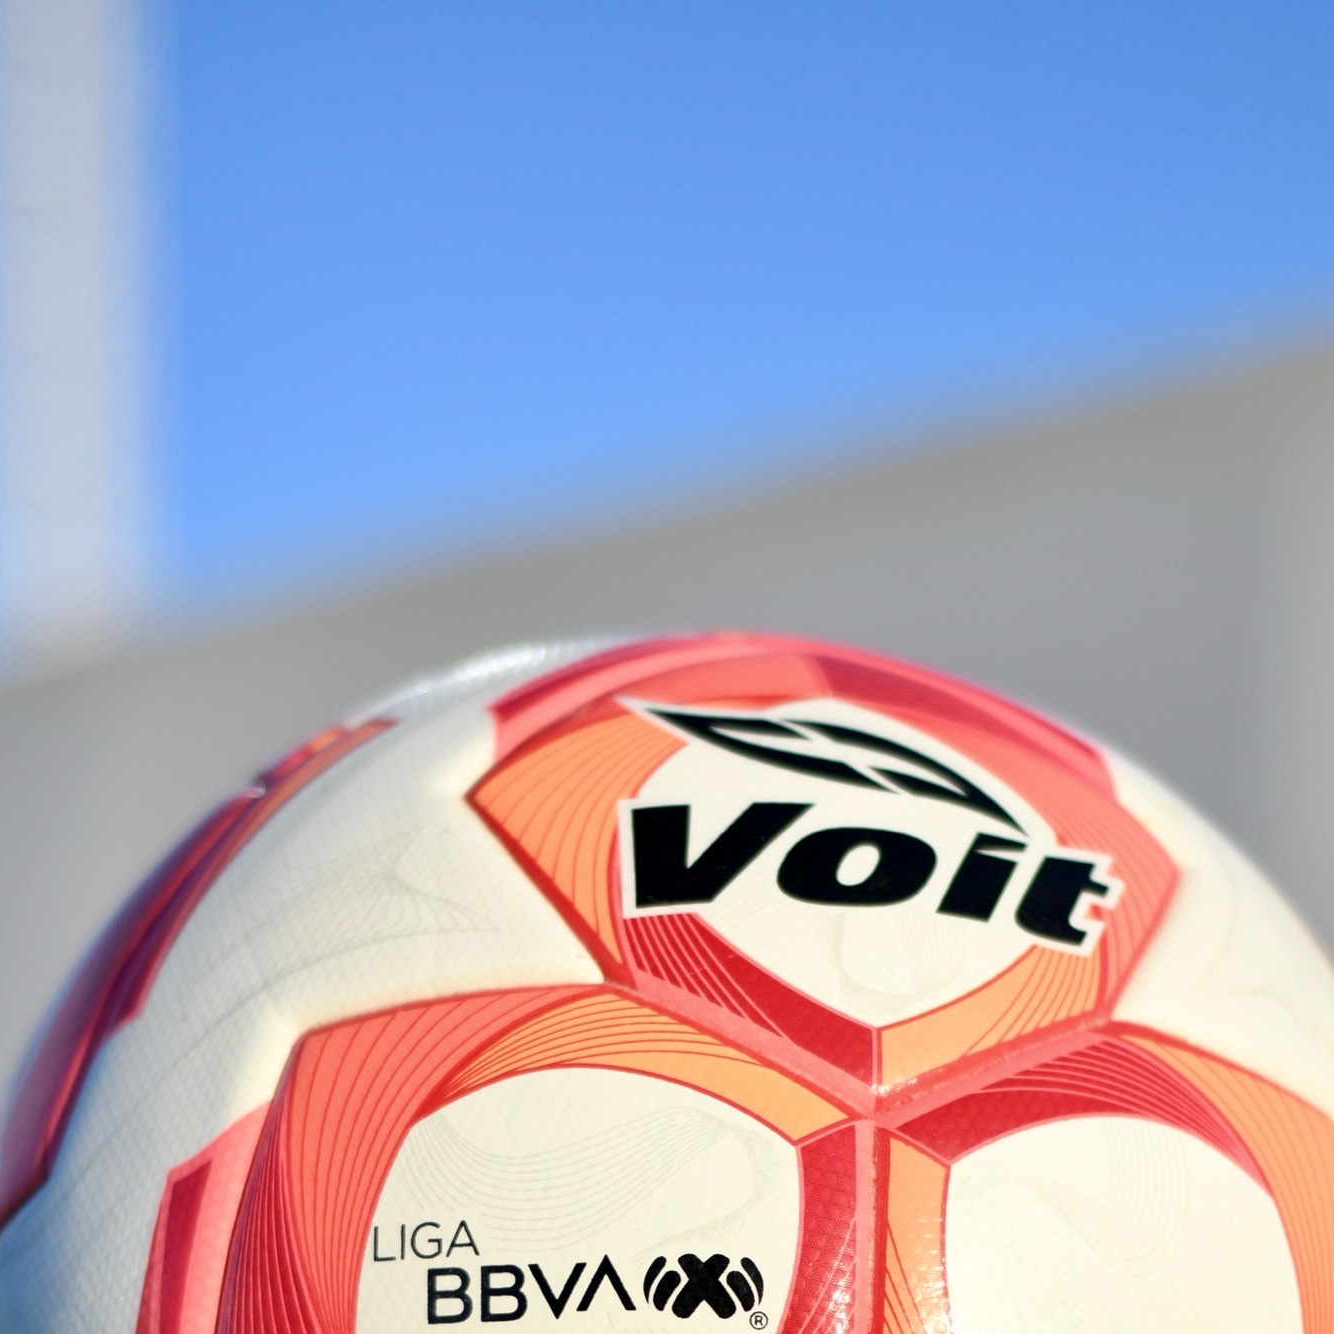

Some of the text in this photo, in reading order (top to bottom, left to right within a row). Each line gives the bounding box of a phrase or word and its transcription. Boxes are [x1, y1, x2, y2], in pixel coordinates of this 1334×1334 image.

[631, 802, 1109, 946] Voit
[373, 1219, 480, 1262] LIGA
[427, 1254, 636, 1325] BBVA
